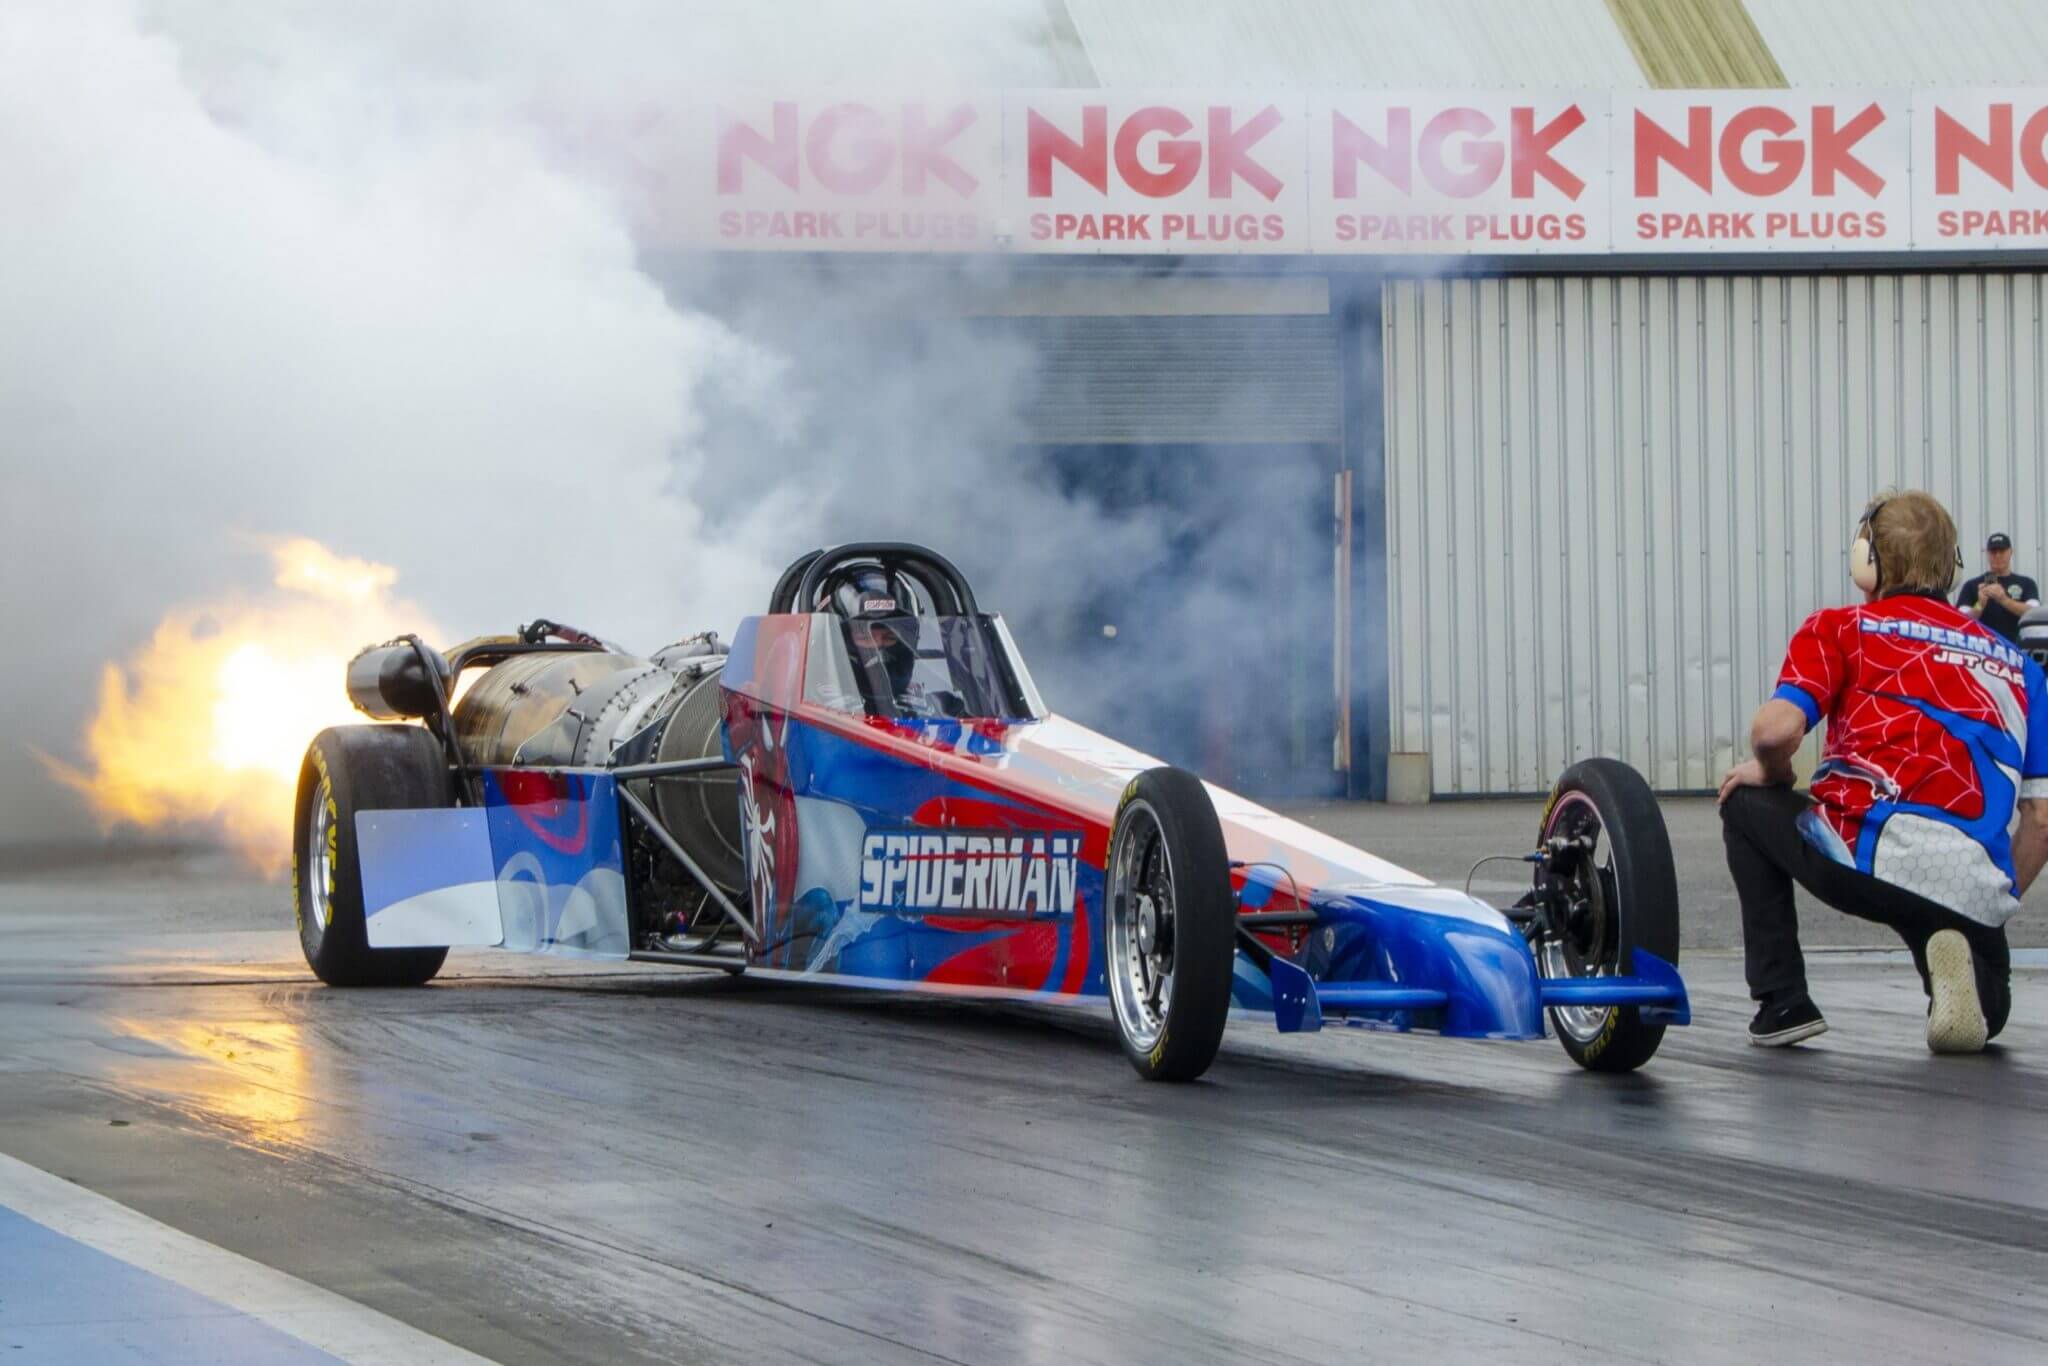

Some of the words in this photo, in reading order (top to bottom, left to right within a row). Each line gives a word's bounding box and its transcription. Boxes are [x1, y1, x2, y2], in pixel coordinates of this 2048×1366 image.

[717, 100, 980, 199] NGK
[1027, 103, 1285, 202] NGK
[1332, 103, 1586, 202] NGK
[1634, 101, 1887, 200] NGK
[719, 210, 844, 239] SPARK
[856, 211, 979, 240] PLUGS
[1030, 213, 1151, 241] SPARK
[1163, 213, 1285, 241] PLUGS
[1336, 213, 1455, 241] SPARK
[1466, 213, 1587, 241] PLUGS
[1637, 213, 1756, 239] SPARK
[1767, 212, 1887, 239] PLUGS
[1861, 618, 2025, 669] SPIDERMAN
[1933, 650, 1980, 668] JET
[1983, 659, 2026, 688] CAR
[861, 835, 1081, 913] SPIDERMAN
